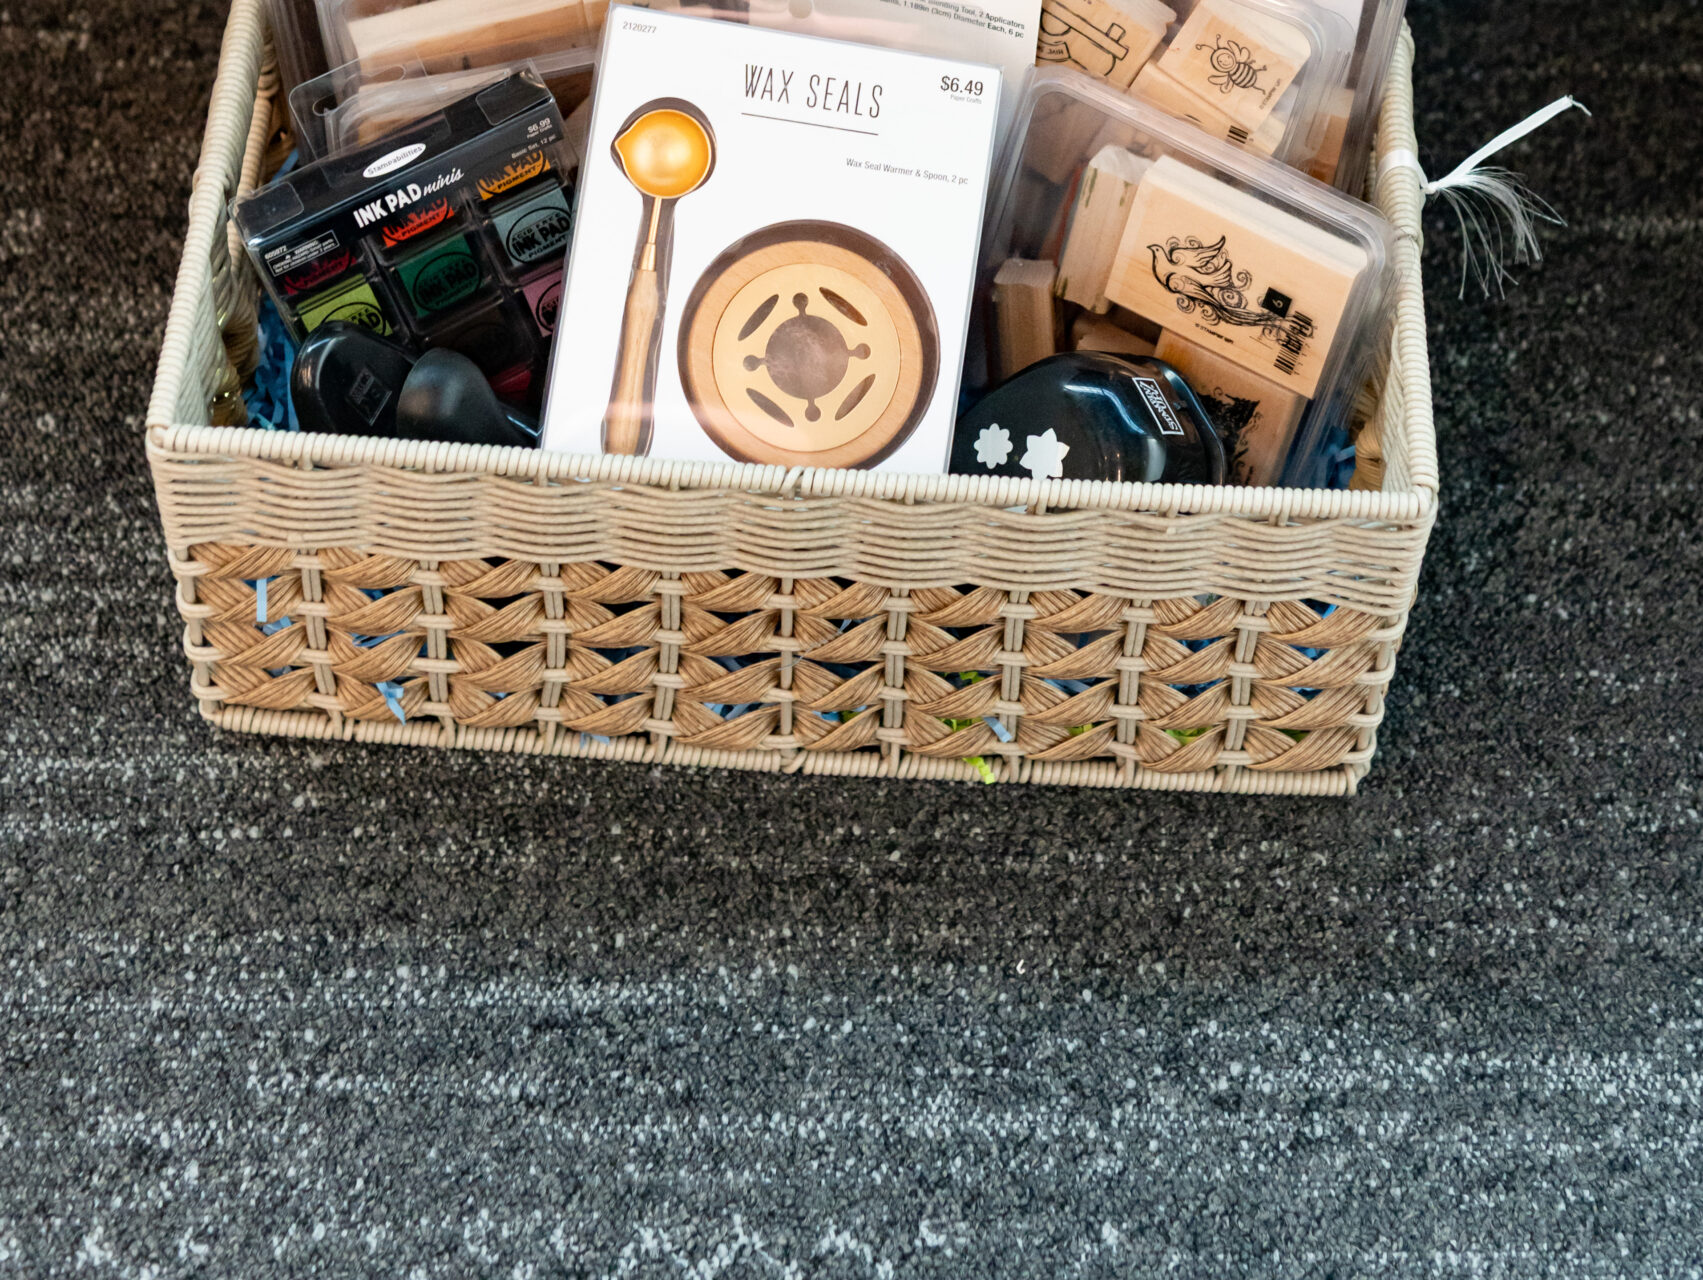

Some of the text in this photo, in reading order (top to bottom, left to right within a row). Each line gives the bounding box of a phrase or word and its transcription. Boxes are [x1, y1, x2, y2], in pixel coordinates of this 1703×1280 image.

[622, 20, 657, 35] 2120277
[953, 11, 985, 28] Diameter
[987, 22, 1007, 34] Each,
[1015, 30, 1024, 39] pc
[985, 12, 1025, 30] Applicators
[744, 63, 884, 119] WAX SEALS
[940, 75, 984, 97] $6.49
[527, 117, 551, 134] $6.99
[366, 145, 423, 176] Stampabilities
[846, 158, 968, 186] Wax Seal Warmer & Spoon, 2 pc
[352, 198, 388, 229] INK
[384, 182, 422, 213] PAD
[423, 167, 464, 196] minis
[511, 216, 571, 257] INK PAD
